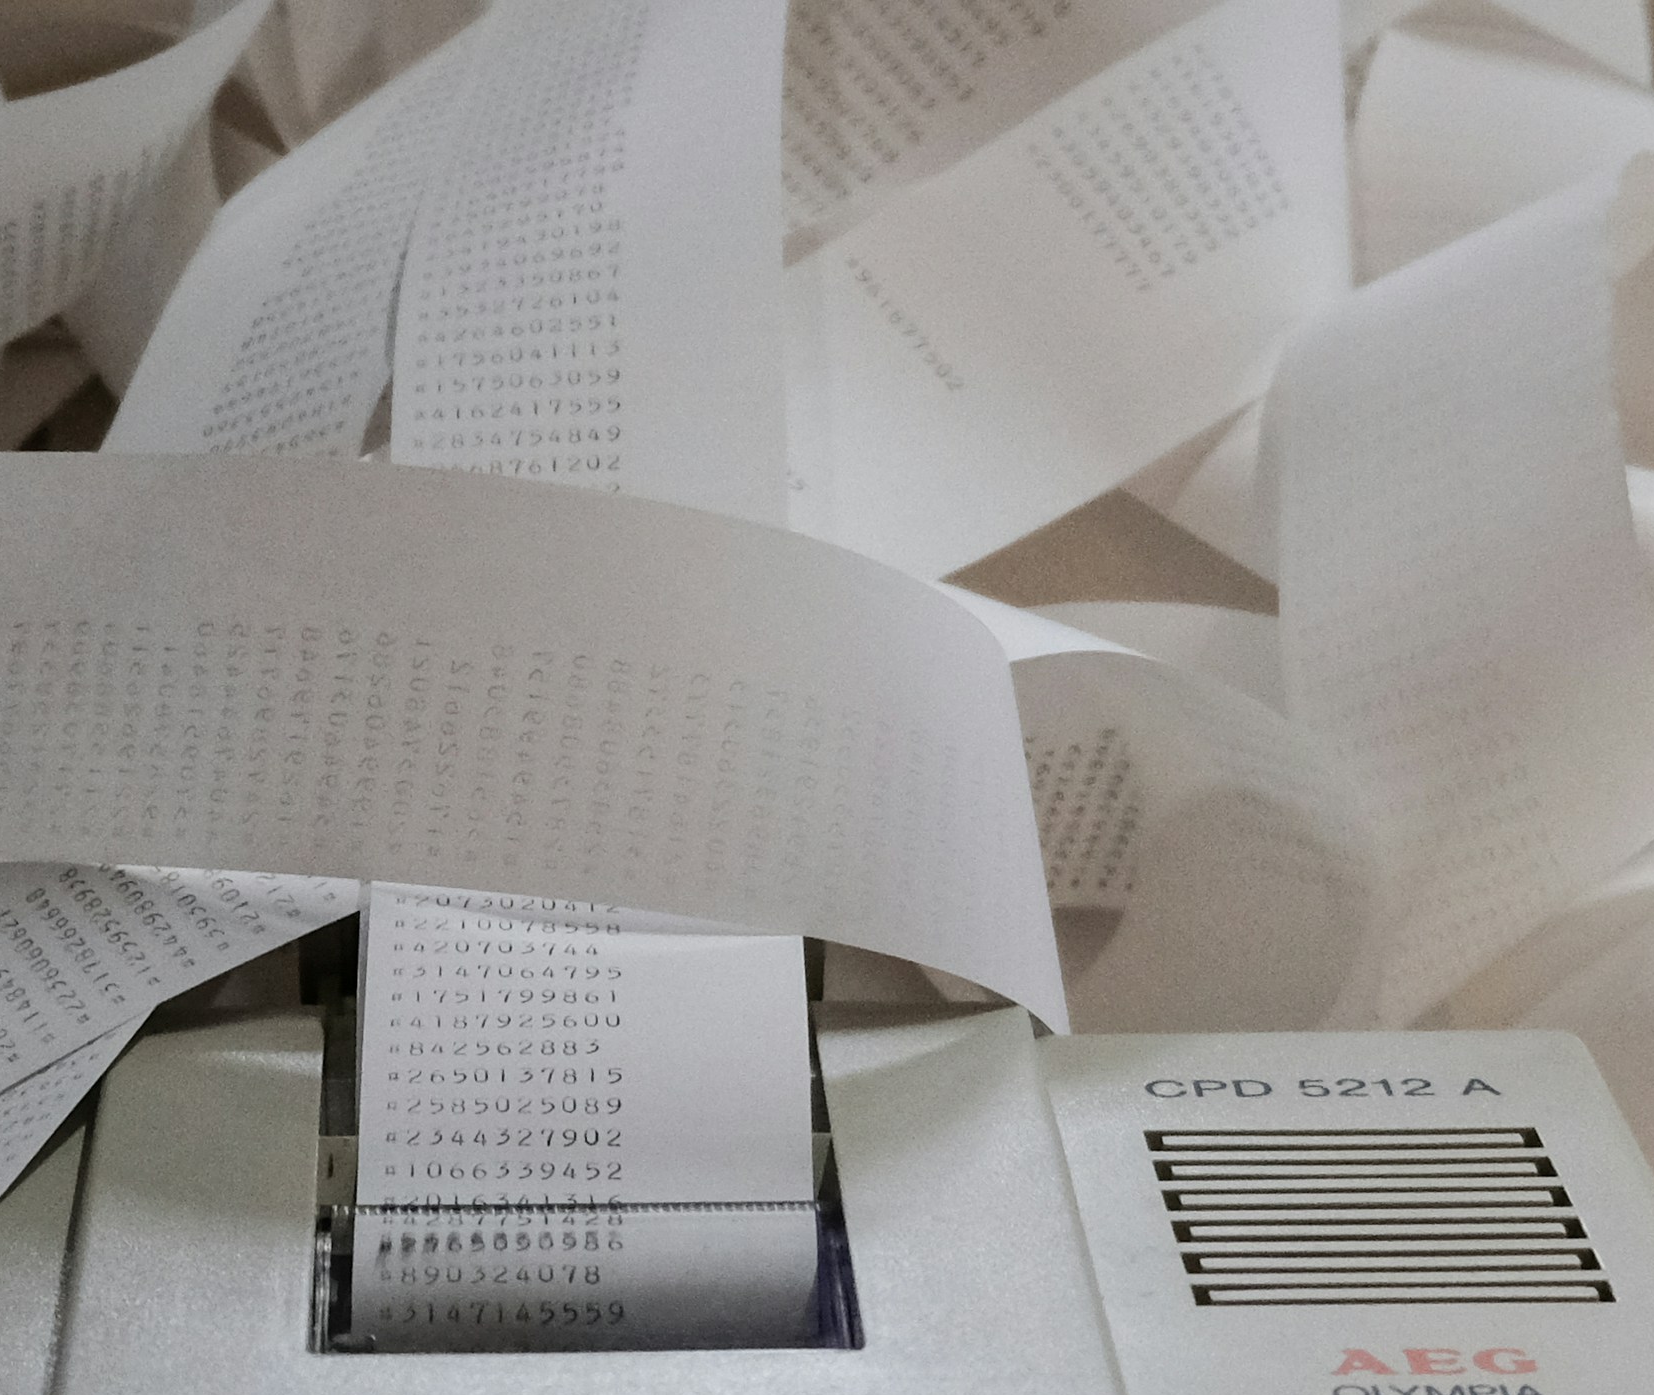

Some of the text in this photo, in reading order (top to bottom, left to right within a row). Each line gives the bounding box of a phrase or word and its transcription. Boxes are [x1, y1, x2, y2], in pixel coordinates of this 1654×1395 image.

[1144, 1077, 1503, 1100] CPD 5212 A
[1331, 1347, 1539, 1376] AEG
